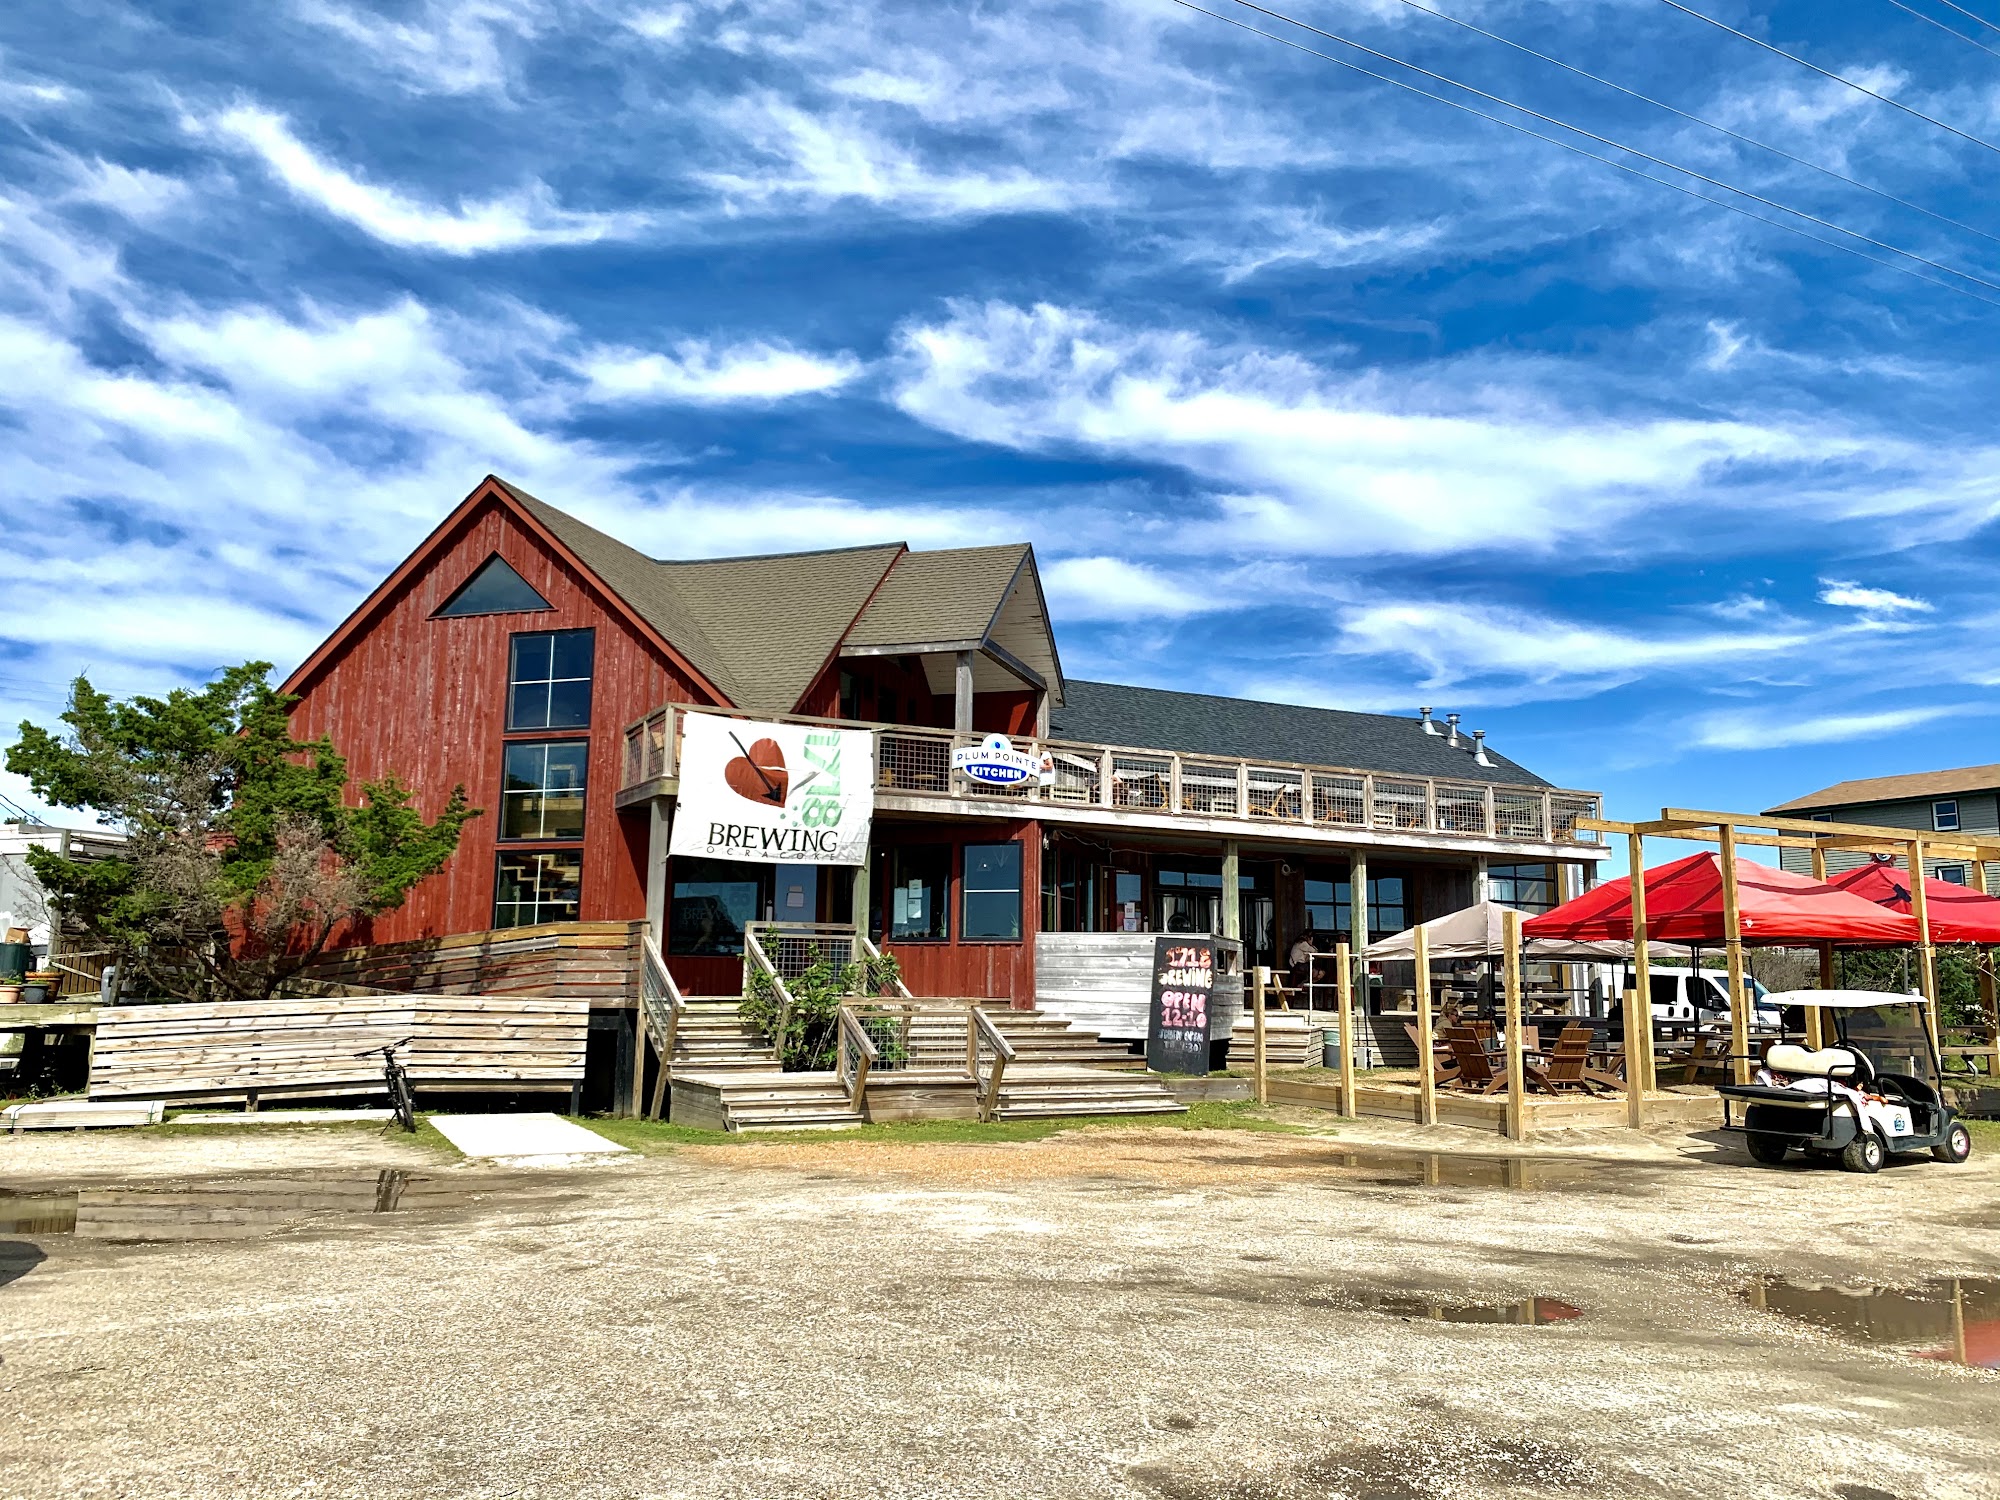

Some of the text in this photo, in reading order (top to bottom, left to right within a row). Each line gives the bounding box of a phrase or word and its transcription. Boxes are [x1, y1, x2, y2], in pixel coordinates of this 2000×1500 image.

[957, 752, 1037, 769] PLUM POINTE
[971, 765, 1022, 779] KITCHEN
[707, 822, 839, 853] BREWING
[706, 845, 835, 861] OCRACOKE
[1166, 947, 1211, 968] 1718
[1161, 991, 1206, 1012] OPEN
